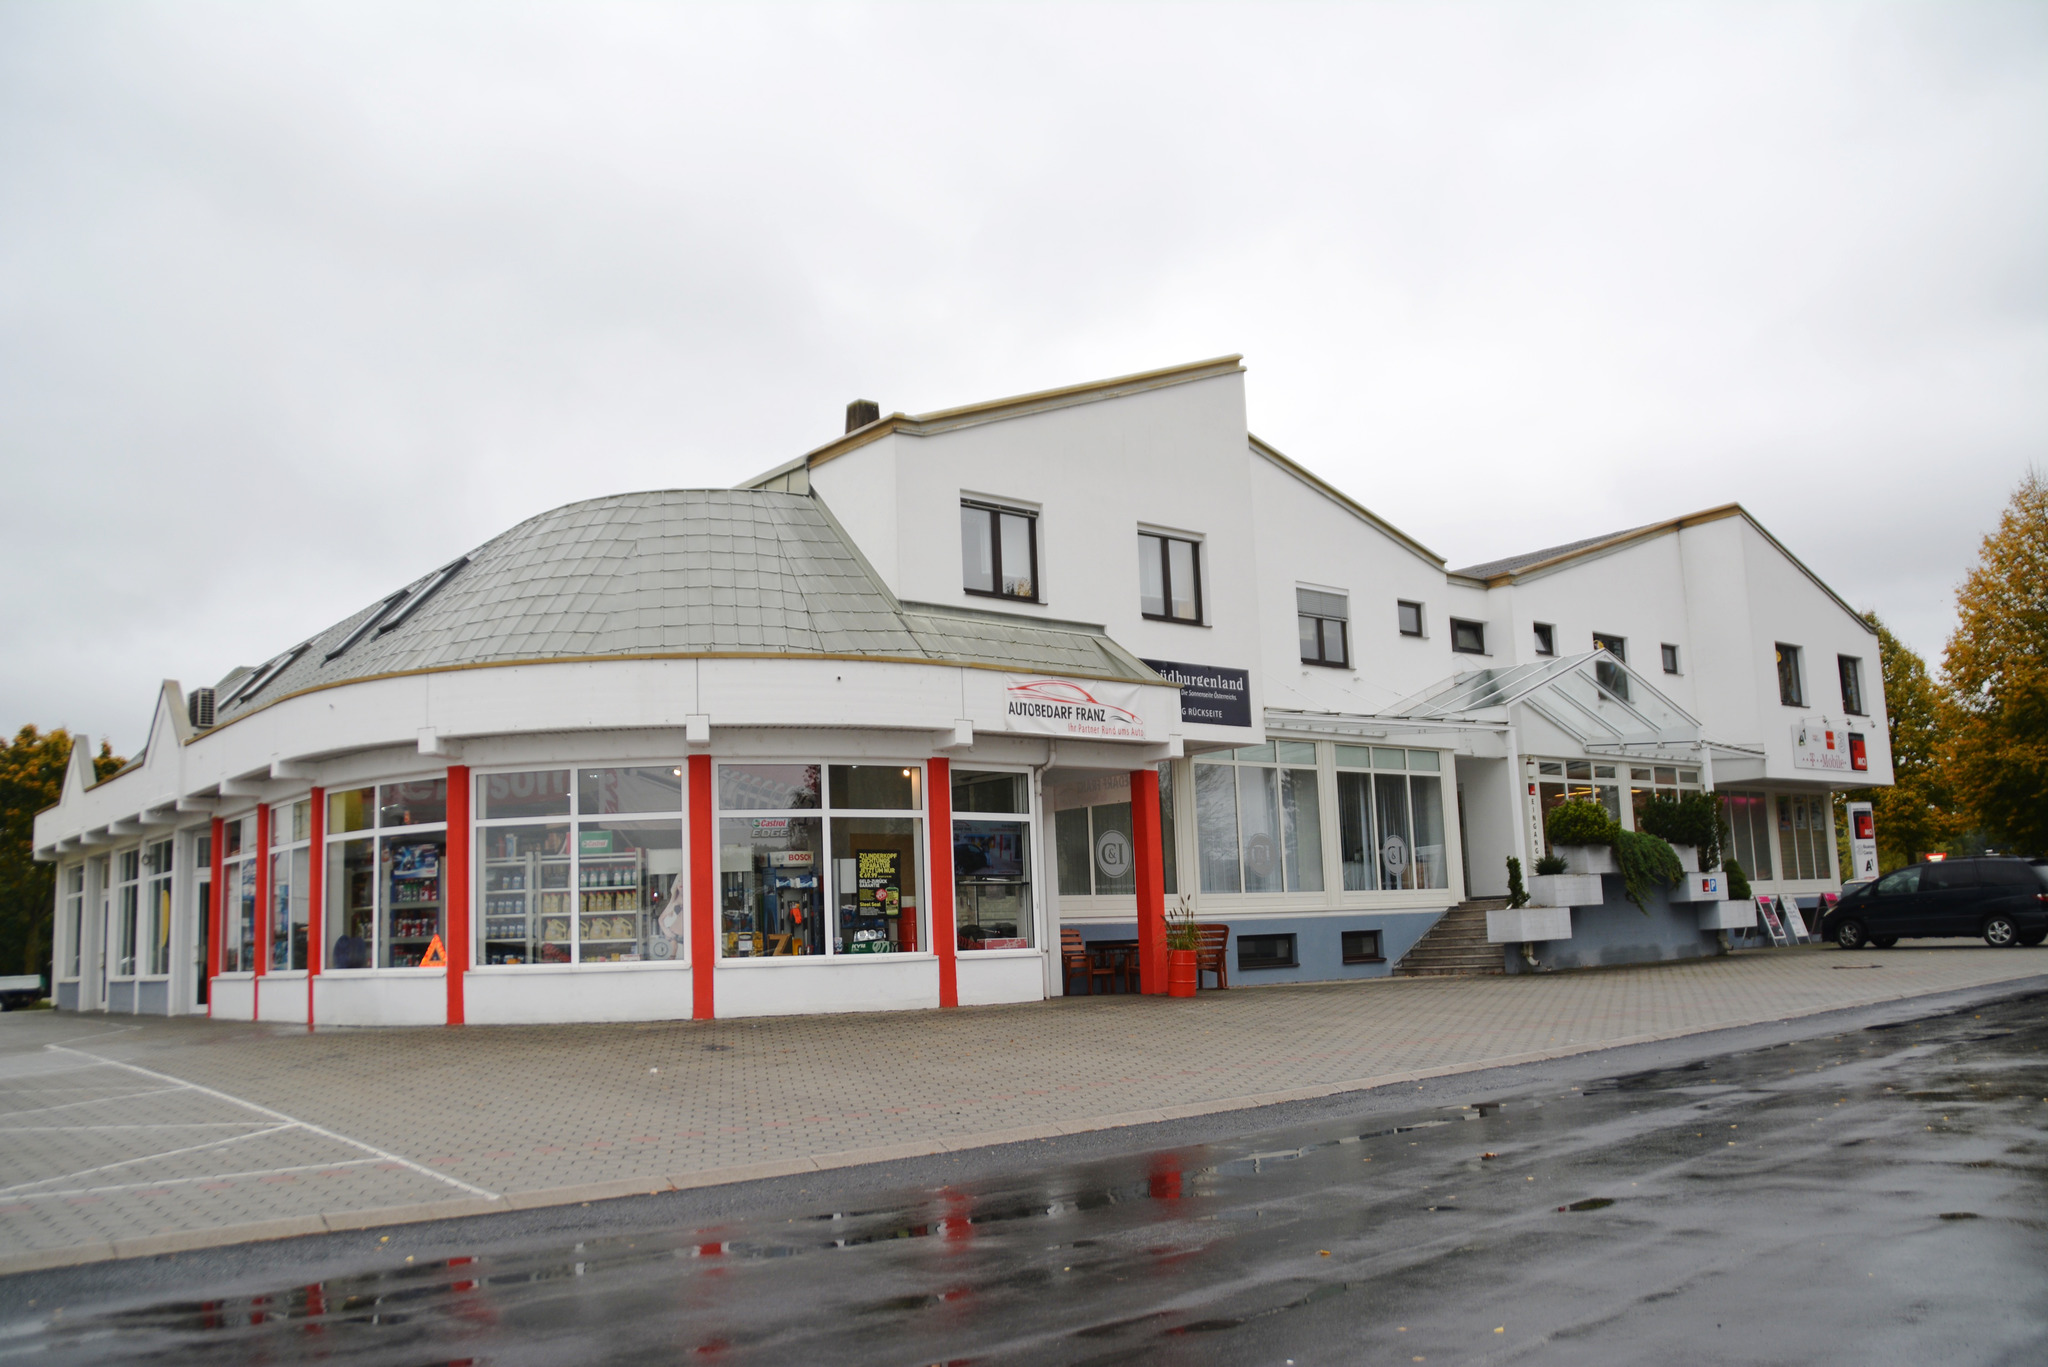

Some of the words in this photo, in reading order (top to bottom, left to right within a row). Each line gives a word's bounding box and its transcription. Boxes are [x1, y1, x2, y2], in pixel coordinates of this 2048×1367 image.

[1160, 669, 1244, 691] üdburgenland
[1189, 689, 1214, 699] Sonnenseite
[1009, 701, 1073, 719] AUTOBEDARF
[1076, 706, 1106, 722] FRANZ
[1188, 706, 1223, 718] RÜCKSEITE
[1068, 723, 1077, 733] Ihr
[1079, 723, 1100, 735] Partner
[1102, 725, 1117, 736] Rund
[1131, 727, 1144, 737] Auto
[761, 819, 786, 828] Castrol
[1531, 798, 1540, 854] EINGANG
[751, 829, 789, 838] EDGE
